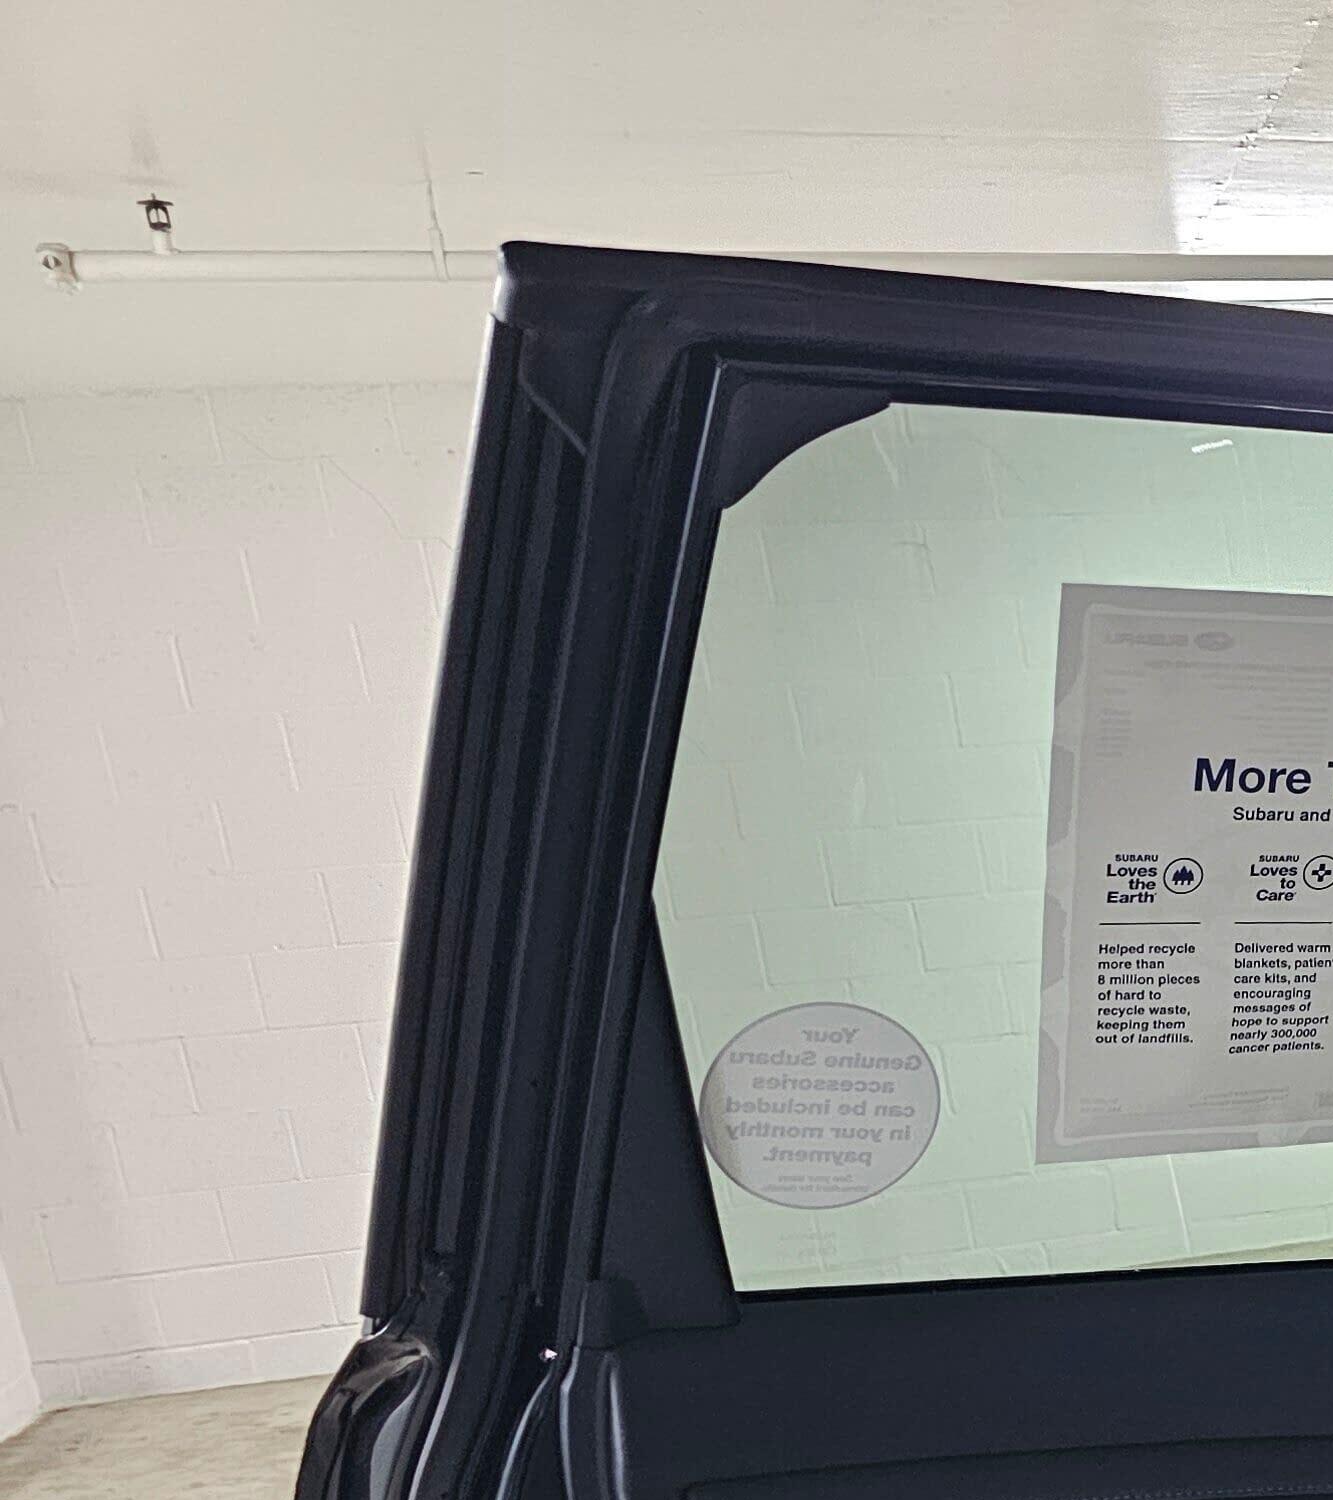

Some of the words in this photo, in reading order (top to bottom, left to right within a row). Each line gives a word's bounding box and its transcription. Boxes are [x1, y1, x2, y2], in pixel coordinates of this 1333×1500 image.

[1194, 758, 1311, 794] More
[1233, 806, 1294, 821] Subaru
[1299, 808, 1331, 822] and
[1115, 854, 1159, 862] SUBARU
[1106, 864, 1157, 877] Loves
[1250, 864, 1298, 877] Loves
[1128, 878, 1156, 890] the
[1280, 878, 1296, 889] to
[1107, 891, 1154, 903] Earth
[1256, 889, 1294, 901] Care
[1099, 944, 1144, 957] Helped
[1149, 943, 1195, 956] recycle
[1235, 942, 1293, 953] Delivered
[1297, 945, 1331, 953] warm
[1098, 961, 1132, 969] more
[1136, 959, 1164, 969] than
[1234, 958, 1291, 970] blankets,
[1098, 974, 1105, 985] 8
[1109, 974, 1154, 985] million
[1158, 974, 1200, 987] pieces
[1234, 975, 1261, 984] care
[1265, 973, 1291, 985] kits,
[1294, 972, 1317, 983] and
[1098, 990, 1111, 1001] of
[1115, 990, 1145, 1000] hard
[1149, 990, 1161, 1000] to
[1233, 987, 1311, 1001] encouraging
[1098, 1005, 1145, 1018] recycle
[1149, 1005, 1190, 1016] waste,
[1233, 1004, 1295, 1015] messages
[1299, 1001, 1311, 1012] of
[1097, 1019, 1149, 1032] keeping
[1153, 1019, 1185, 1029] them
[1231, 1017, 1262, 1028] hope
[1266, 1017, 1278, 1026] to
[1282, 1015, 1329, 1027] support
[1095, 1034, 1117, 1043] out
[1121, 1033, 1135, 1044] of
[1138, 1033, 1193, 1043] landfills.
[1230, 1029, 1267, 1041] nearly
[1271, 1028, 1317, 1039] 300,000
[1229, 1044, 1270, 1054] cancer
[1273, 1041, 1324, 1053] patients.
